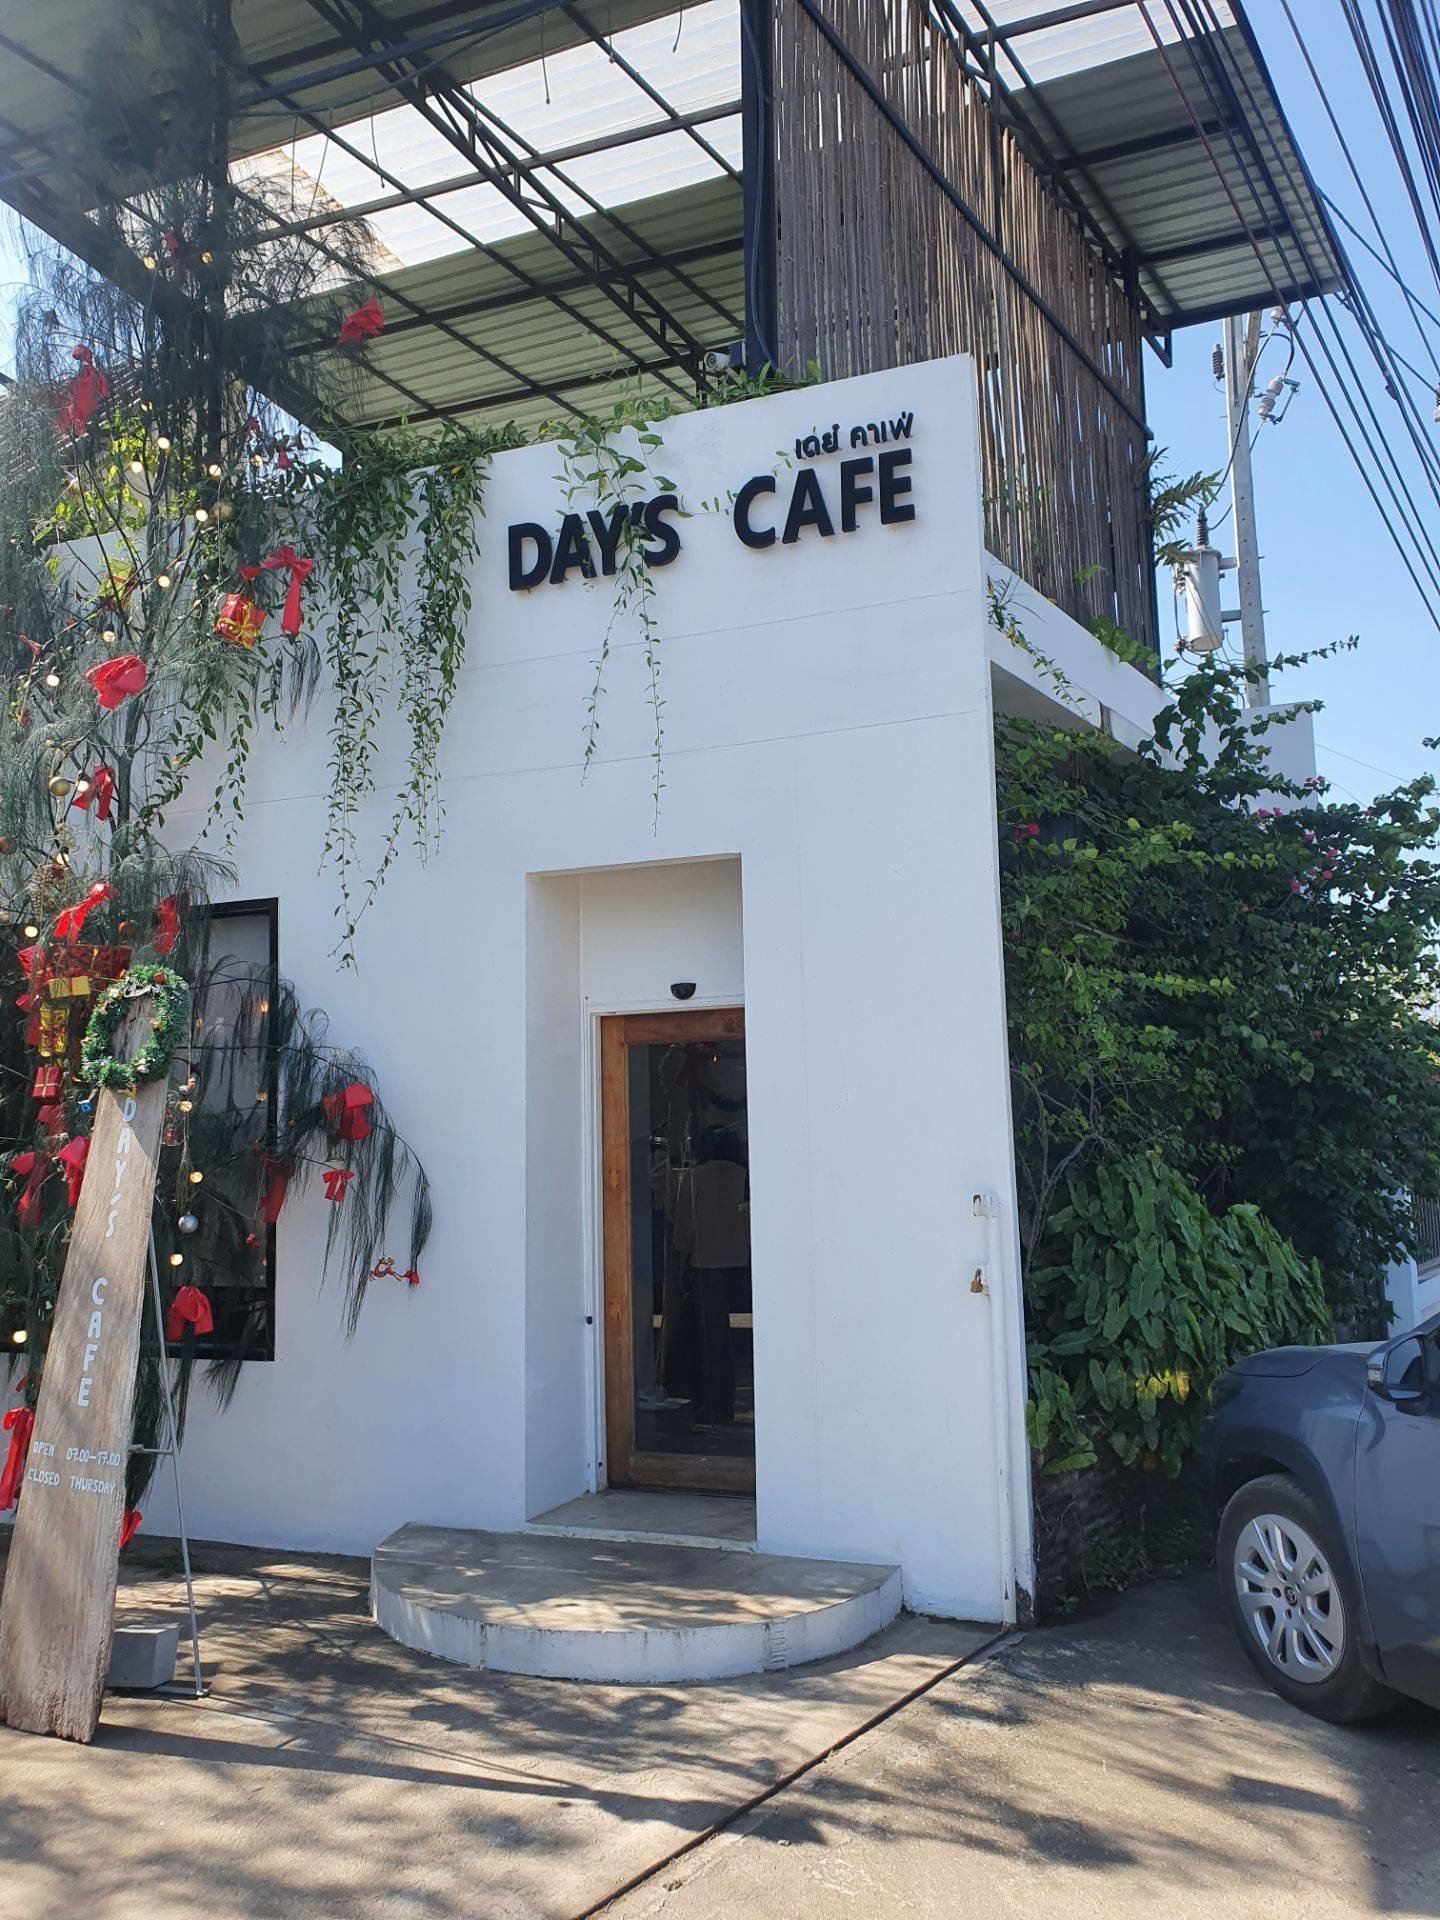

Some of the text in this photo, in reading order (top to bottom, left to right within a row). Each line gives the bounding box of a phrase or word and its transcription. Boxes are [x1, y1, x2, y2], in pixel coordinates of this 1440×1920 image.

[508, 447, 916, 591] DAY'S CAFE
[78, 1097, 136, 1407] DAY'S CAFE
[27, 1467, 116, 1495] CLOSED THURSDAY
[33, 1441, 56, 1457] OPEN
